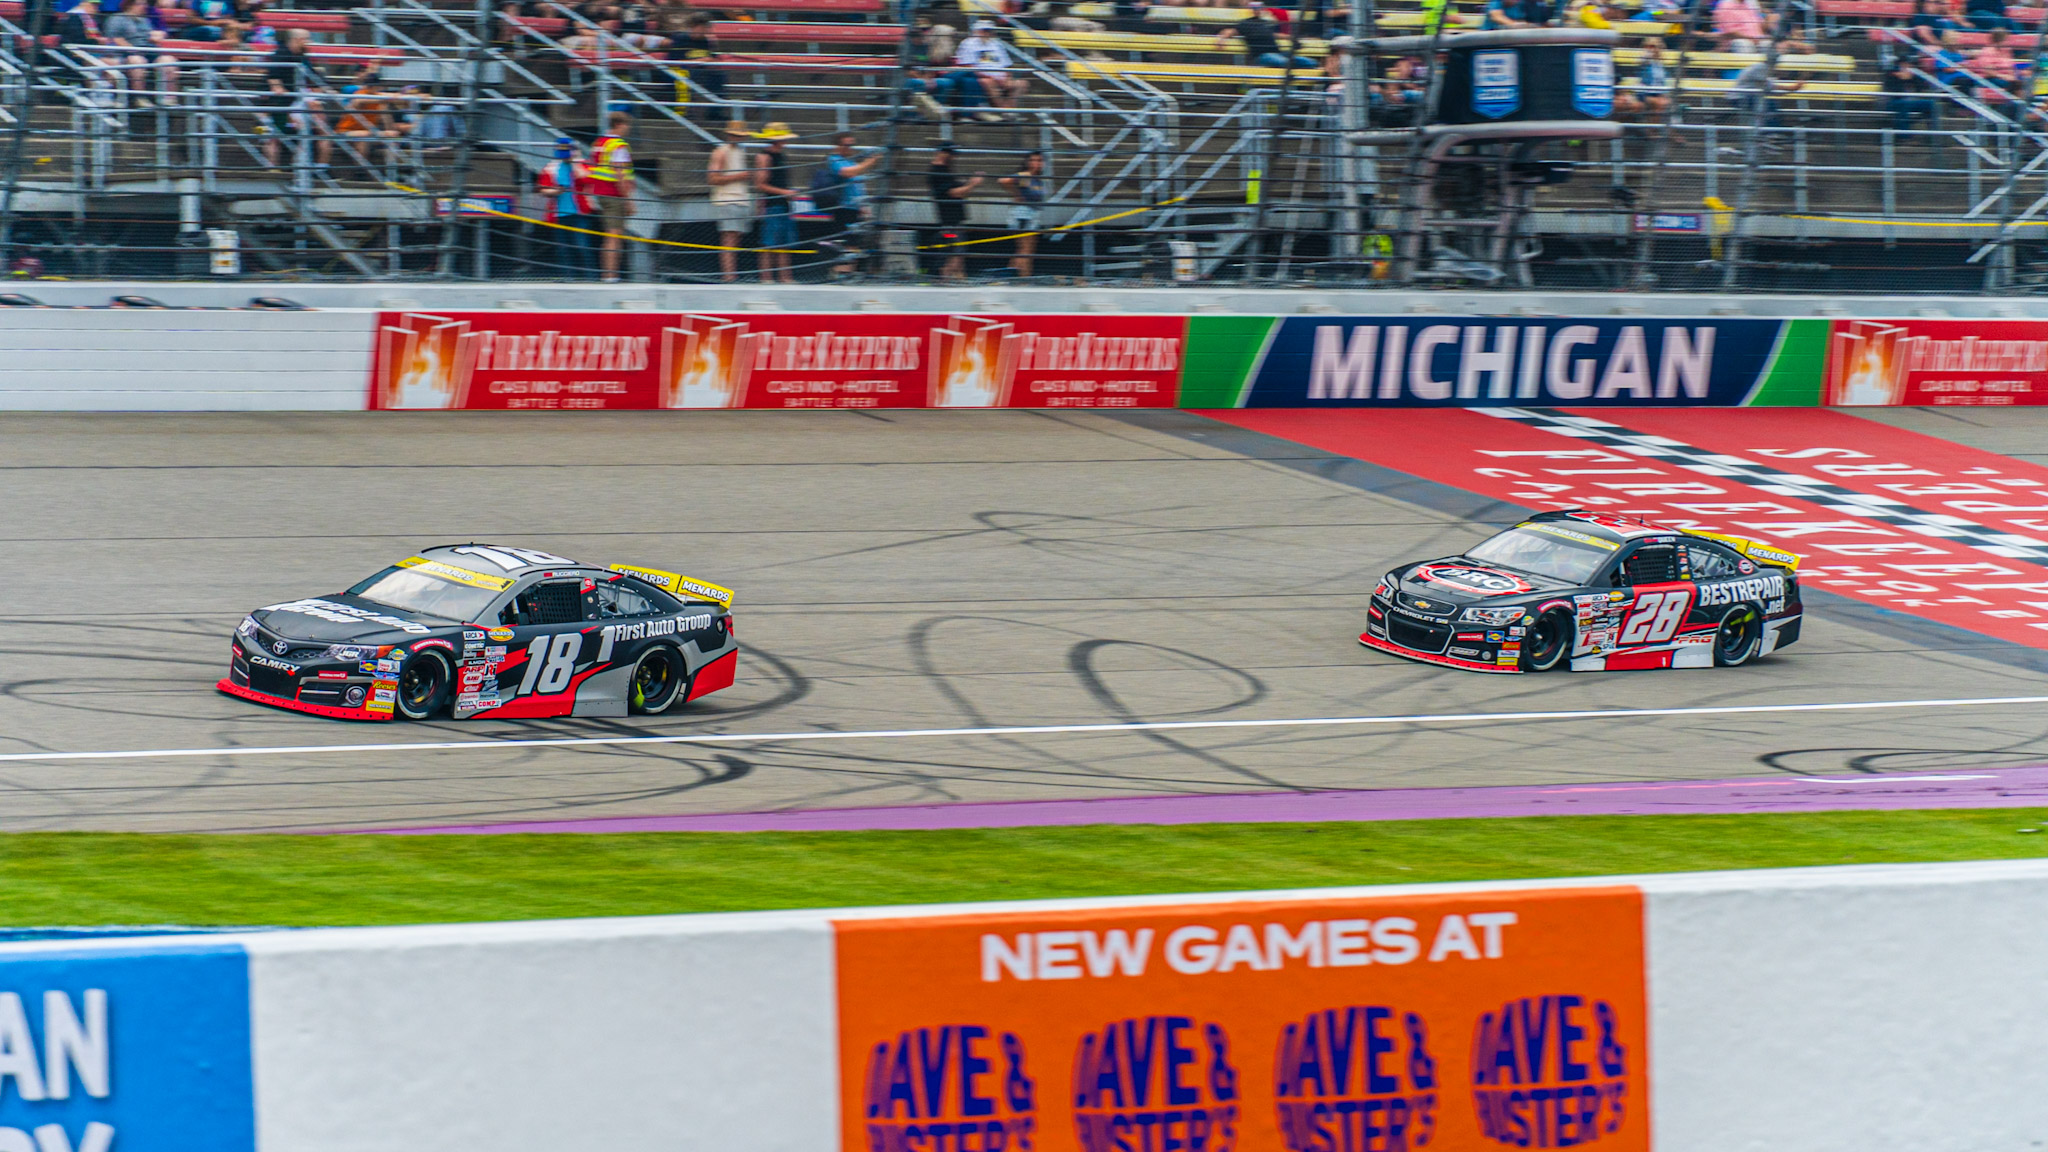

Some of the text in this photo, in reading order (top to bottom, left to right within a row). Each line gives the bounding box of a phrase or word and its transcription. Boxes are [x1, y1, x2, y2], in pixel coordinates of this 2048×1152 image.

[1307, 325, 1717, 400] MICHIGAN
[1541, 525, 1591, 541] MENARDS
[1747, 546, 1795, 564] MENARDS
[420, 563, 474, 581] MENARDS
[1434, 568, 1513, 589] BRC
[682, 580, 730, 602] MENARDS
[1700, 575, 1785, 606] BESTREPAIR
[1392, 606, 1435, 622] CHEVROLET
[1765, 596, 1785, 614] .net
[614, 623, 645, 642] First
[646, 618, 675, 638] Auto
[675, 613, 711, 633] Group
[1618, 591, 1690, 643] 28
[250, 655, 300, 673] CAMRY
[516, 632, 583, 695] 18
[980, 911, 1518, 983] NEW GAMES AT
